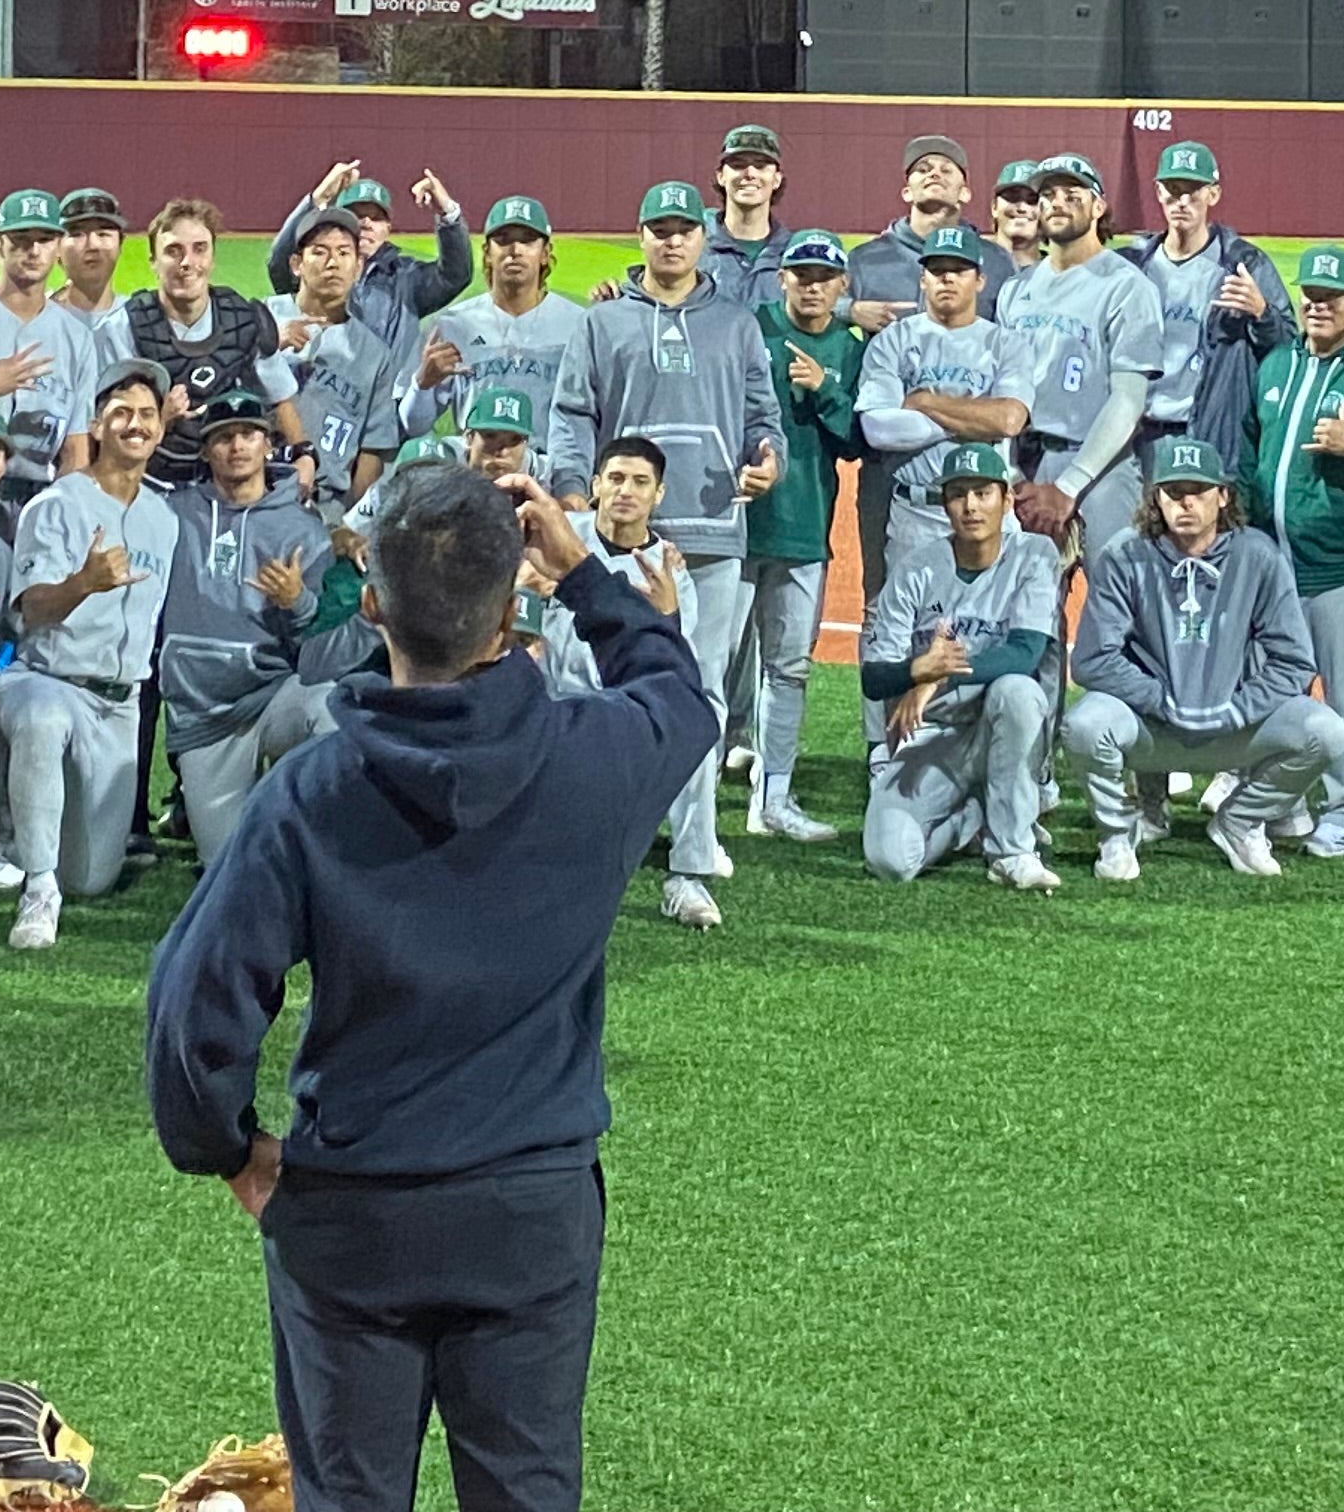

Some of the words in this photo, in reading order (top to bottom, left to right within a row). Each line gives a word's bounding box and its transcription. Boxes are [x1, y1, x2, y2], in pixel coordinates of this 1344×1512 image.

[1133, 109, 1172, 131] 402
[1063, 356, 1085, 392] 6
[320, 413, 355, 457] 37
